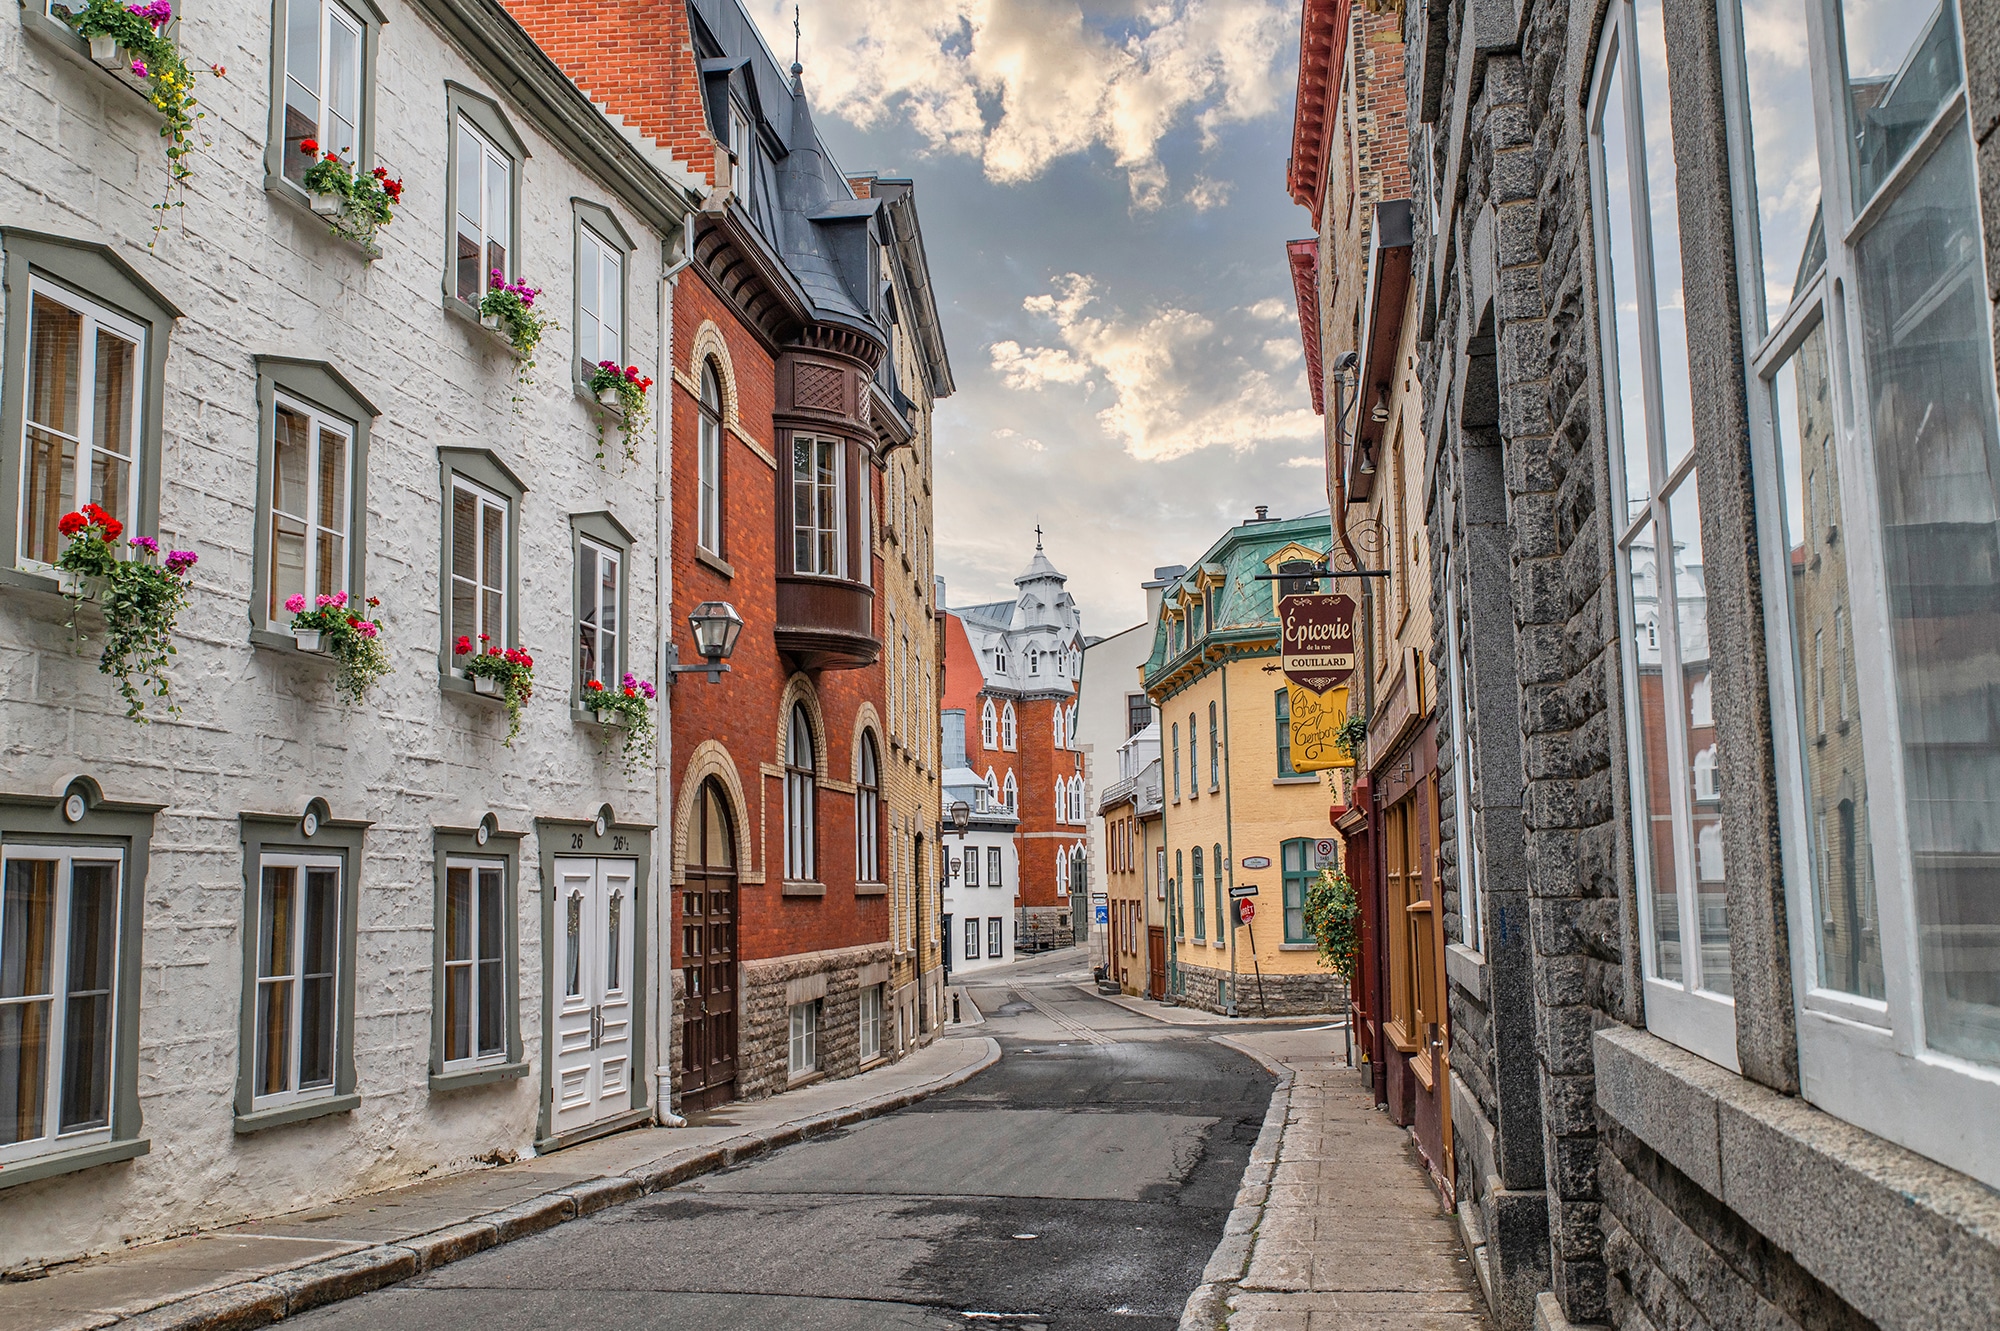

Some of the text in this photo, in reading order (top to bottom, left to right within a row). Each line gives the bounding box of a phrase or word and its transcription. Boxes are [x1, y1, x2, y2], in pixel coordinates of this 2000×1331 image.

[1285, 608, 1351, 650] Épicerie
[1291, 657, 1346, 667] COUILLARD
[571, 833, 583, 849] 26
